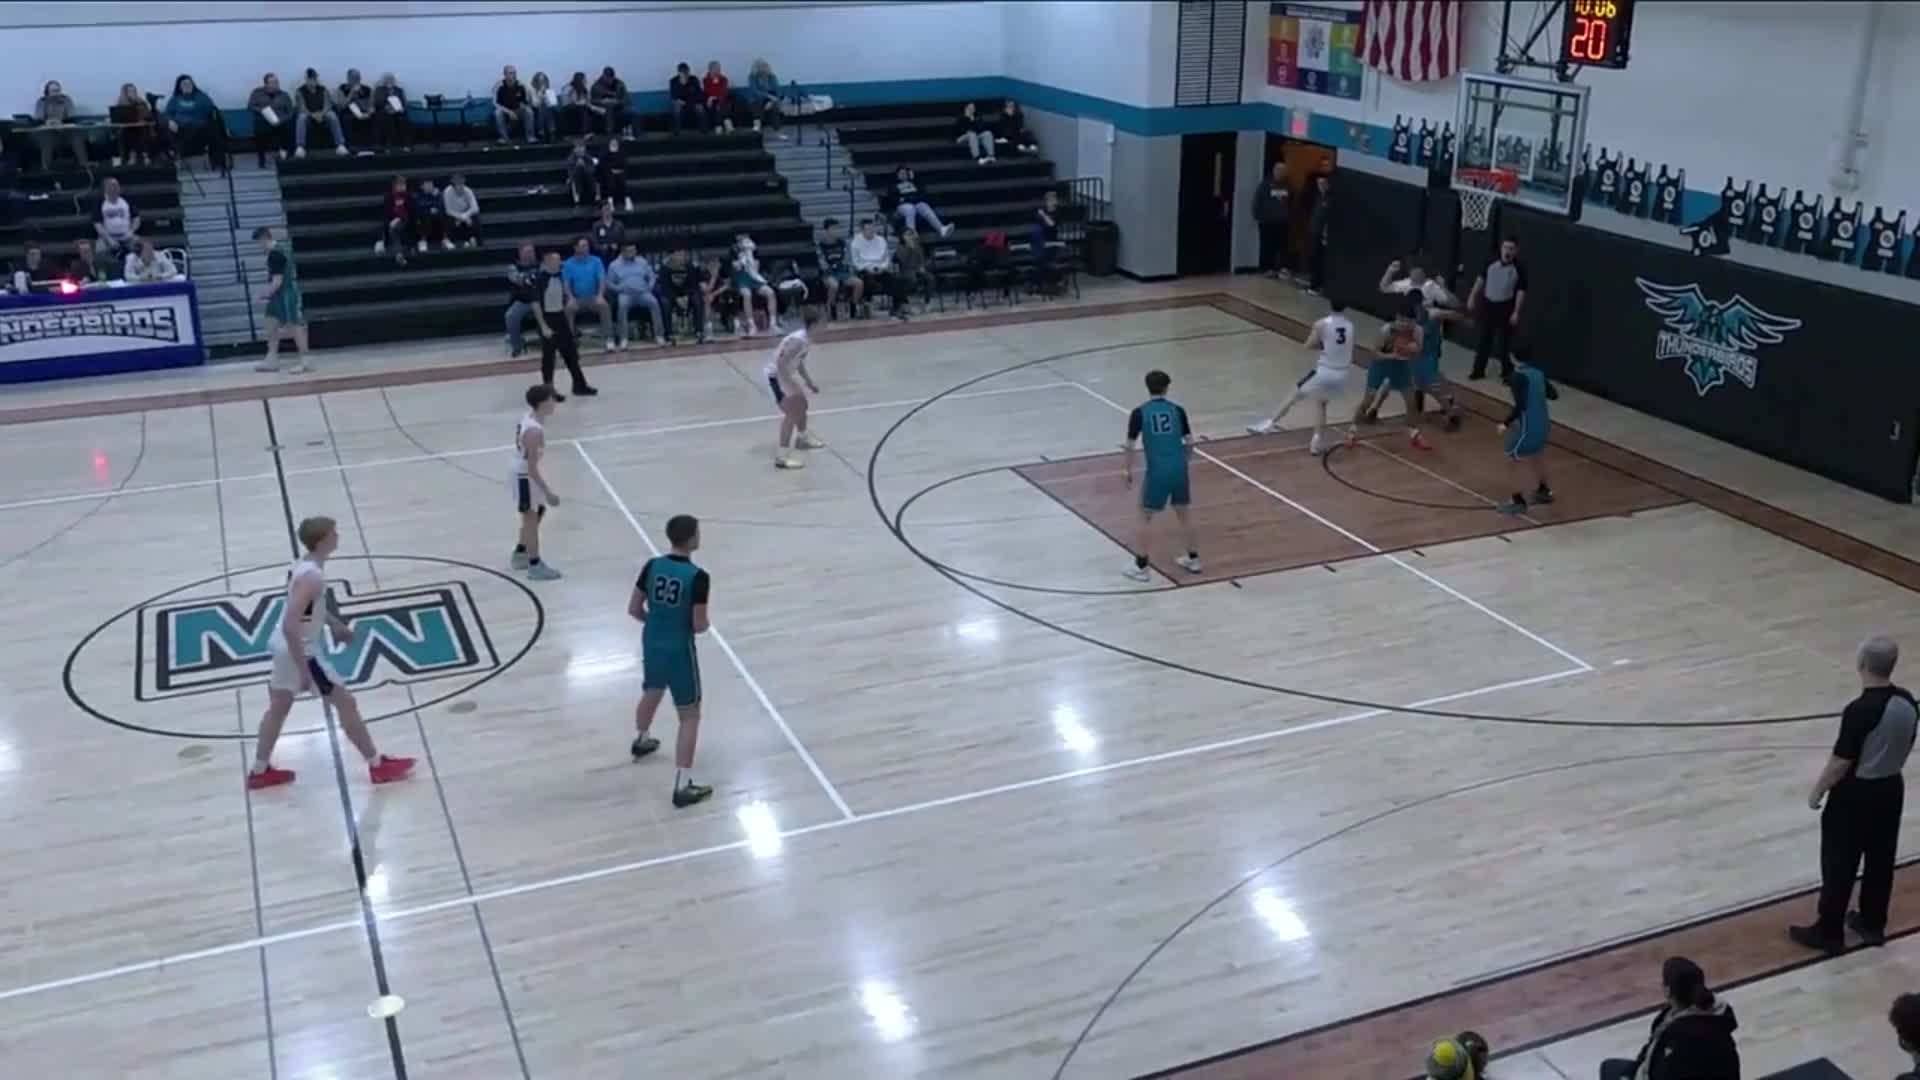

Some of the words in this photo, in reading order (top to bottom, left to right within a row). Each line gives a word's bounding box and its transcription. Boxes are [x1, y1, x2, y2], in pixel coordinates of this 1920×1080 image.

[1571, 17, 1606, 59] 20
[1336, 327, 1347, 345] 3
[1151, 412, 1172, 434] 12
[655, 576, 681, 606] 23
